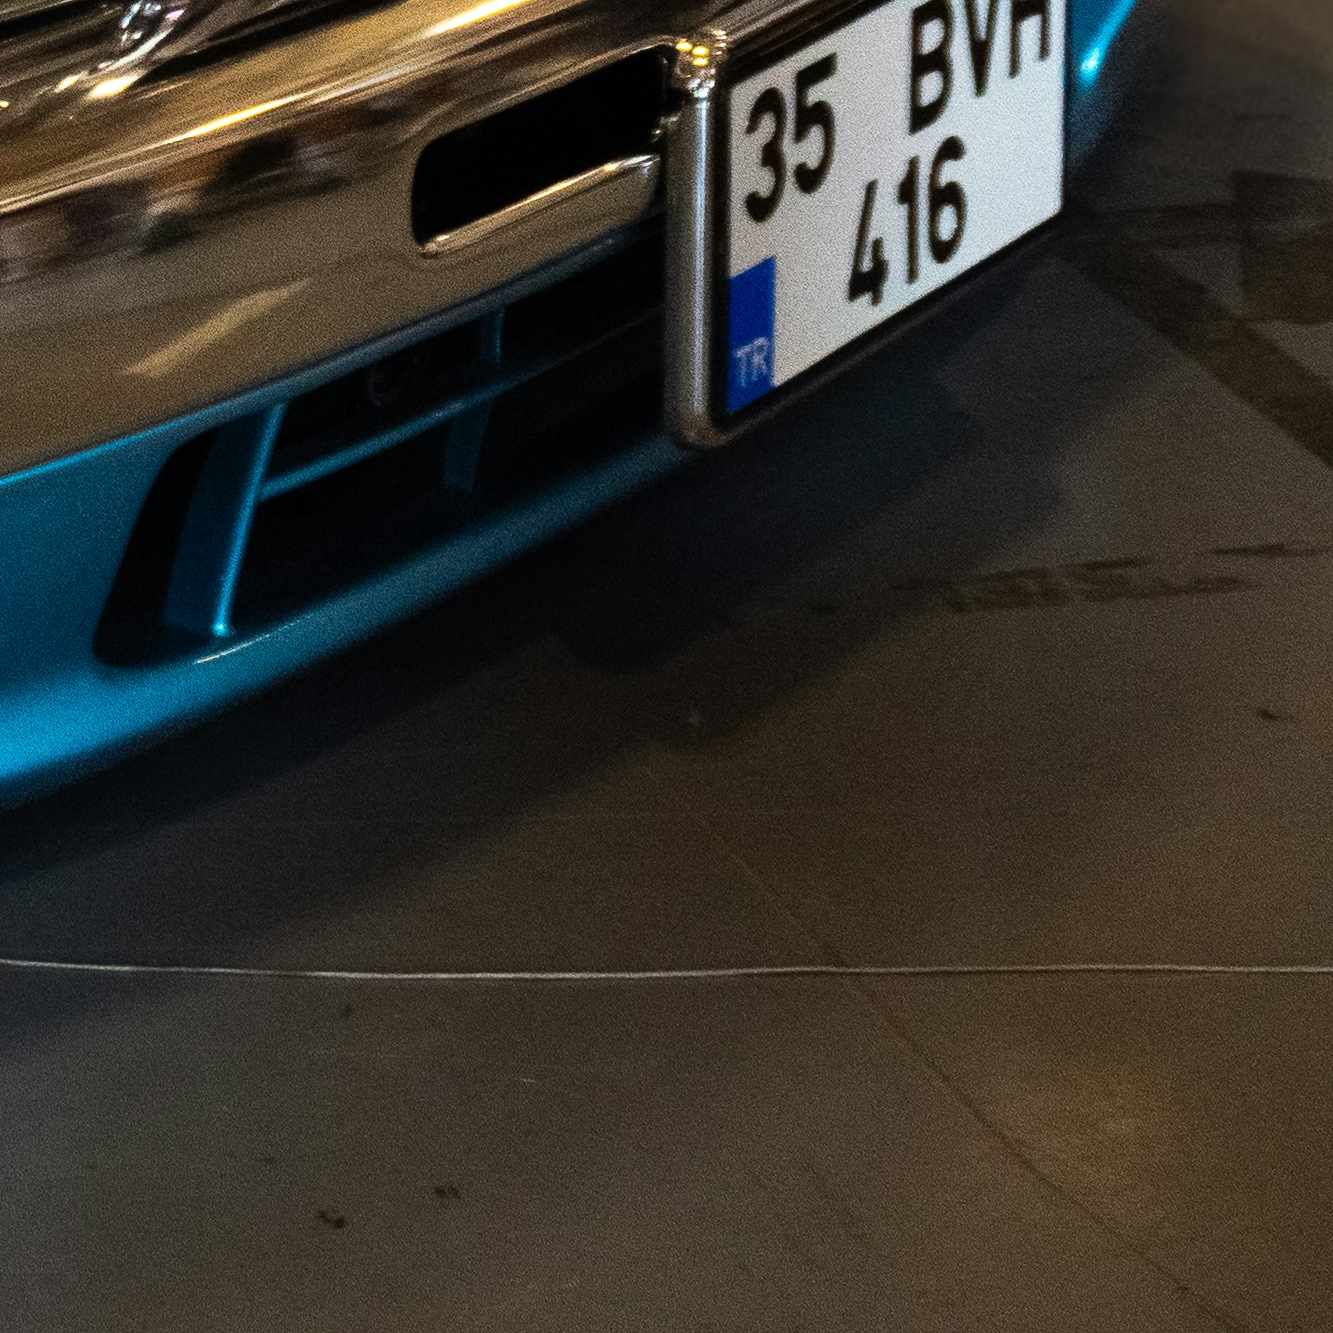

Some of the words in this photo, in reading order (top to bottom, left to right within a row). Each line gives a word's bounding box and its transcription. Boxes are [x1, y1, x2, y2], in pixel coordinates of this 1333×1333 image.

[744, 53, 837, 224] 35
[848, 136, 967, 305] 416
[736, 336, 770, 388] TR
